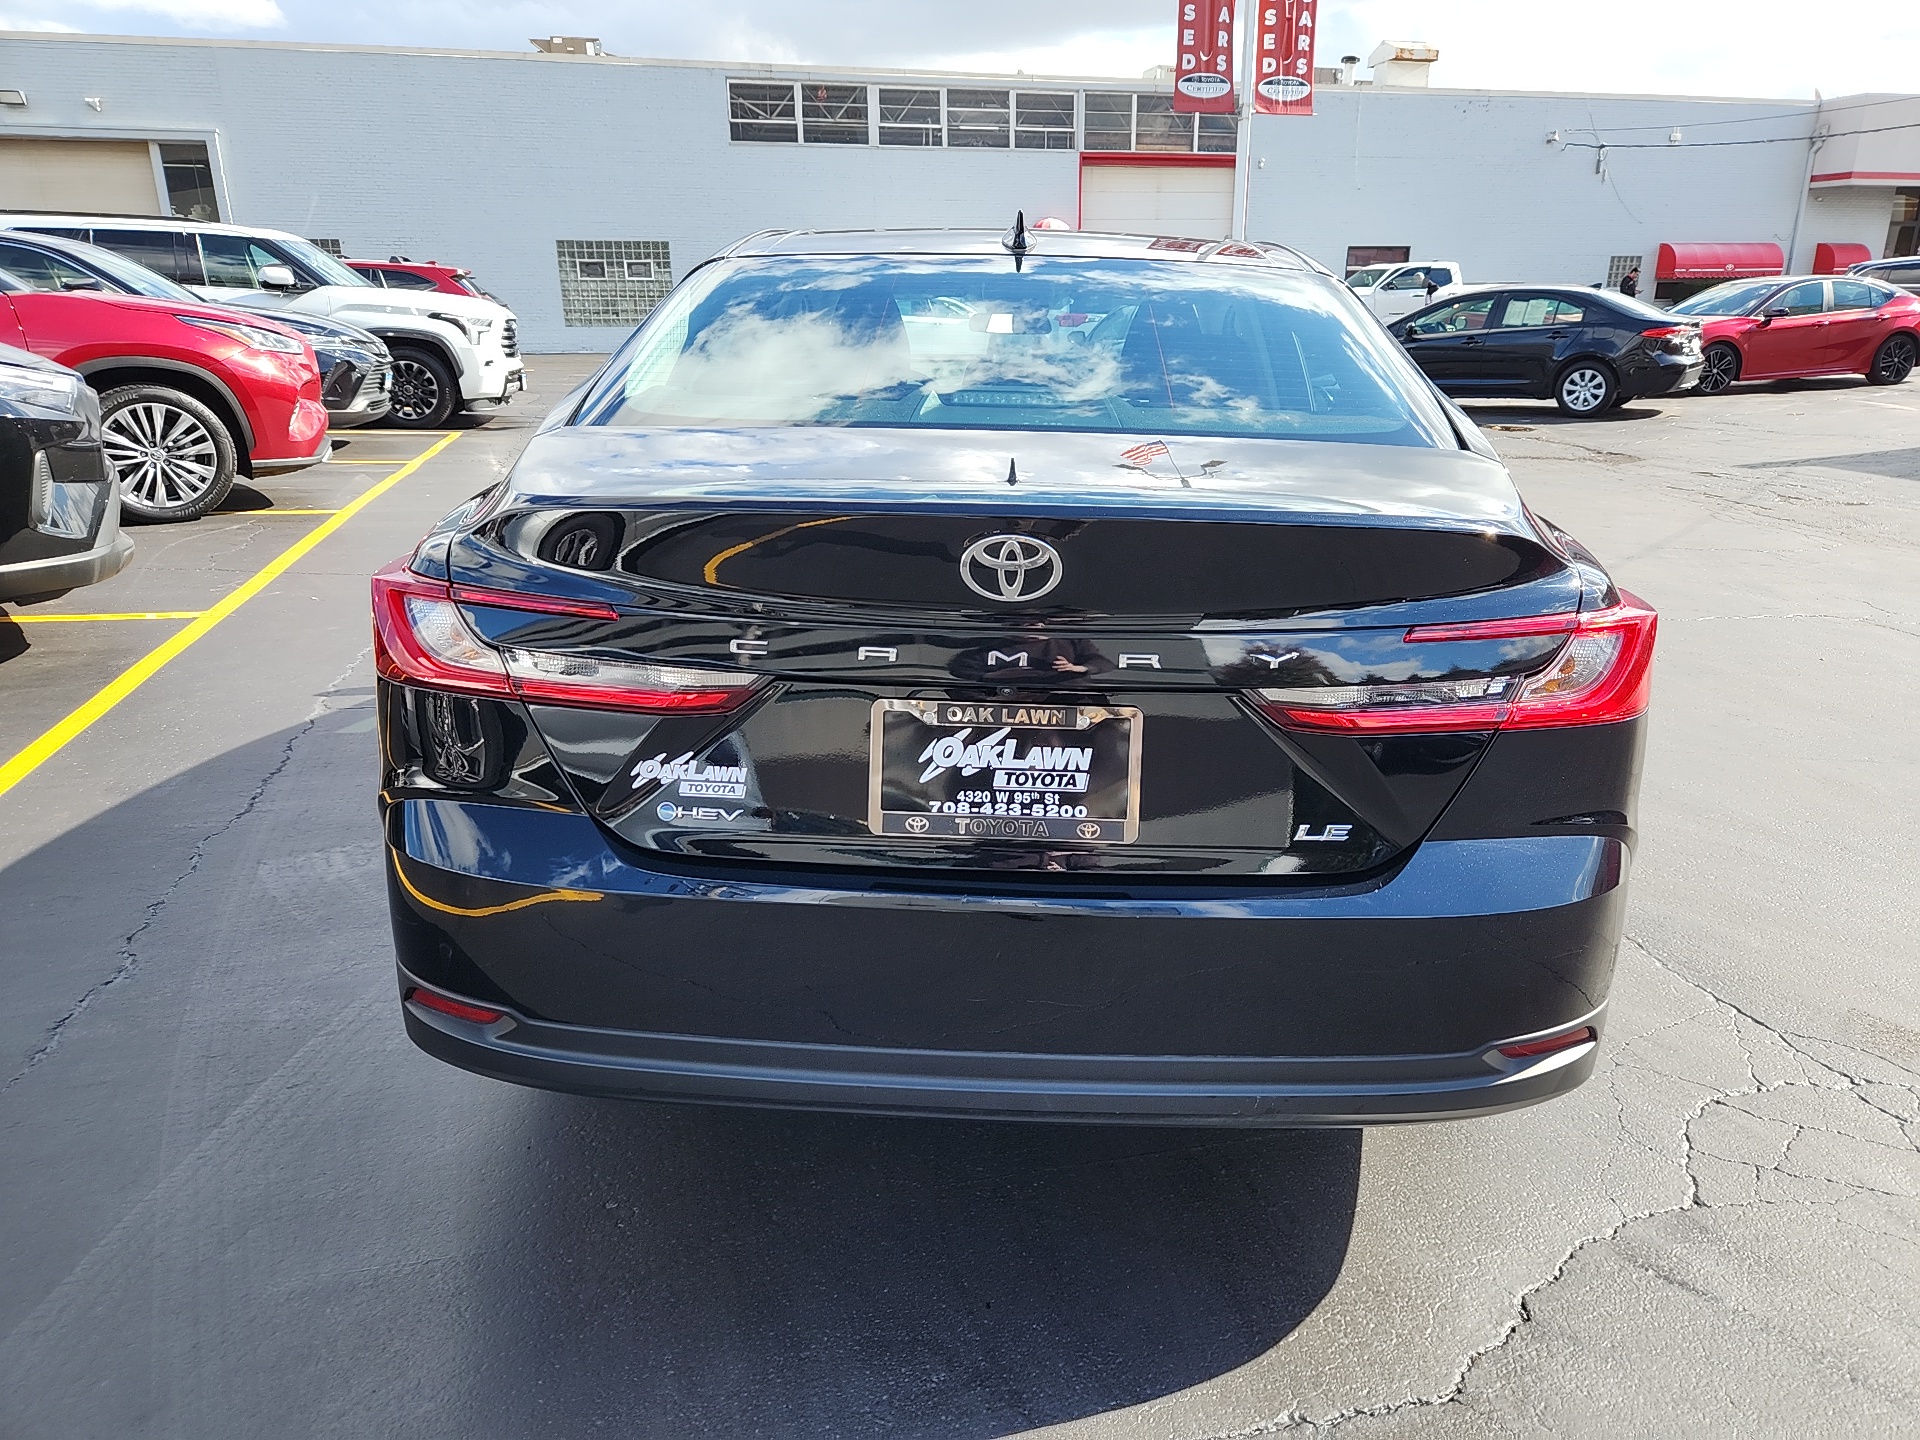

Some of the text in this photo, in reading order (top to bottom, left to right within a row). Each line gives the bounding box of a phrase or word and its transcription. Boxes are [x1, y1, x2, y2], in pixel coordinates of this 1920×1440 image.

[1262, 0, 1277, 74] SED
[1295, 0, 1312, 75] ARS
[729, 638, 1300, 669] CAMRY
[946, 706, 1066, 726] OAK LAWN
[1004, 771, 1077, 788] TOYOTA
[687, 783, 736, 795] TOYOTA
[956, 790, 1060, 805] 4320 W 95th St
[677, 805, 745, 822] HEV
[928, 800, 1088, 818] 708-423-5200
[955, 817, 1049, 837] TOYOTA
[1293, 824, 1353, 842] LE
